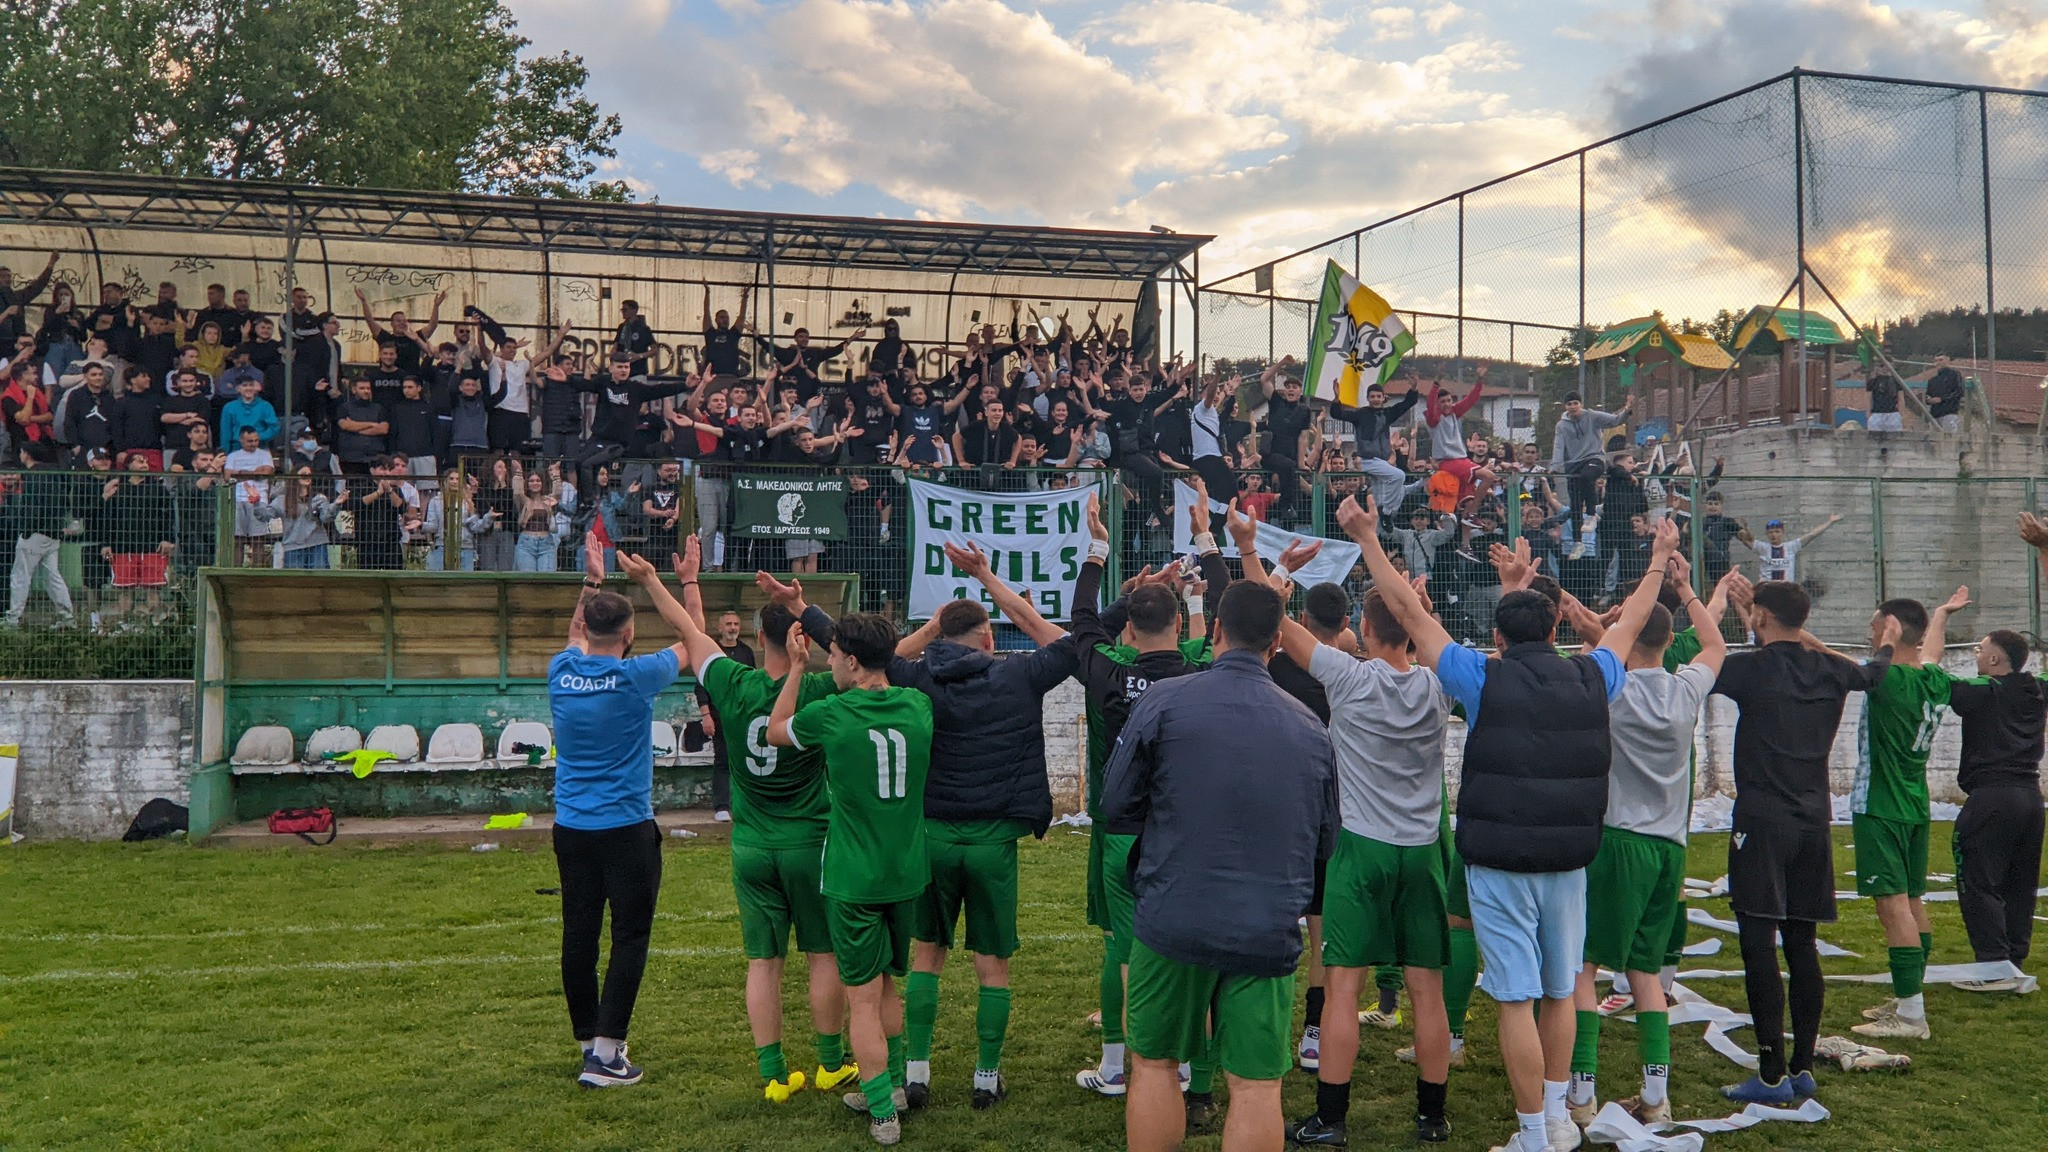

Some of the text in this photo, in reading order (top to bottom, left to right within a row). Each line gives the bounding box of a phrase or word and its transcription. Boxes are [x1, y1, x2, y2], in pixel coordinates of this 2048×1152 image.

[1327, 314, 1393, 364] 1949
[756, 480, 814, 492] ΜΑΚΕΔΟΝΙΚΟΣ
[816, 481, 843, 492] ΛΗΤΗΣ
[751, 525, 830, 535] ΕΤΟΣ ΙΔΡΥΣΕΩΣ 1949
[927, 497, 1080, 535] GREEN
[953, 586, 1062, 620] 99
[560, 674, 617, 692] COACH
[745, 715, 778, 777] 9
[868, 728, 907, 799] 11
